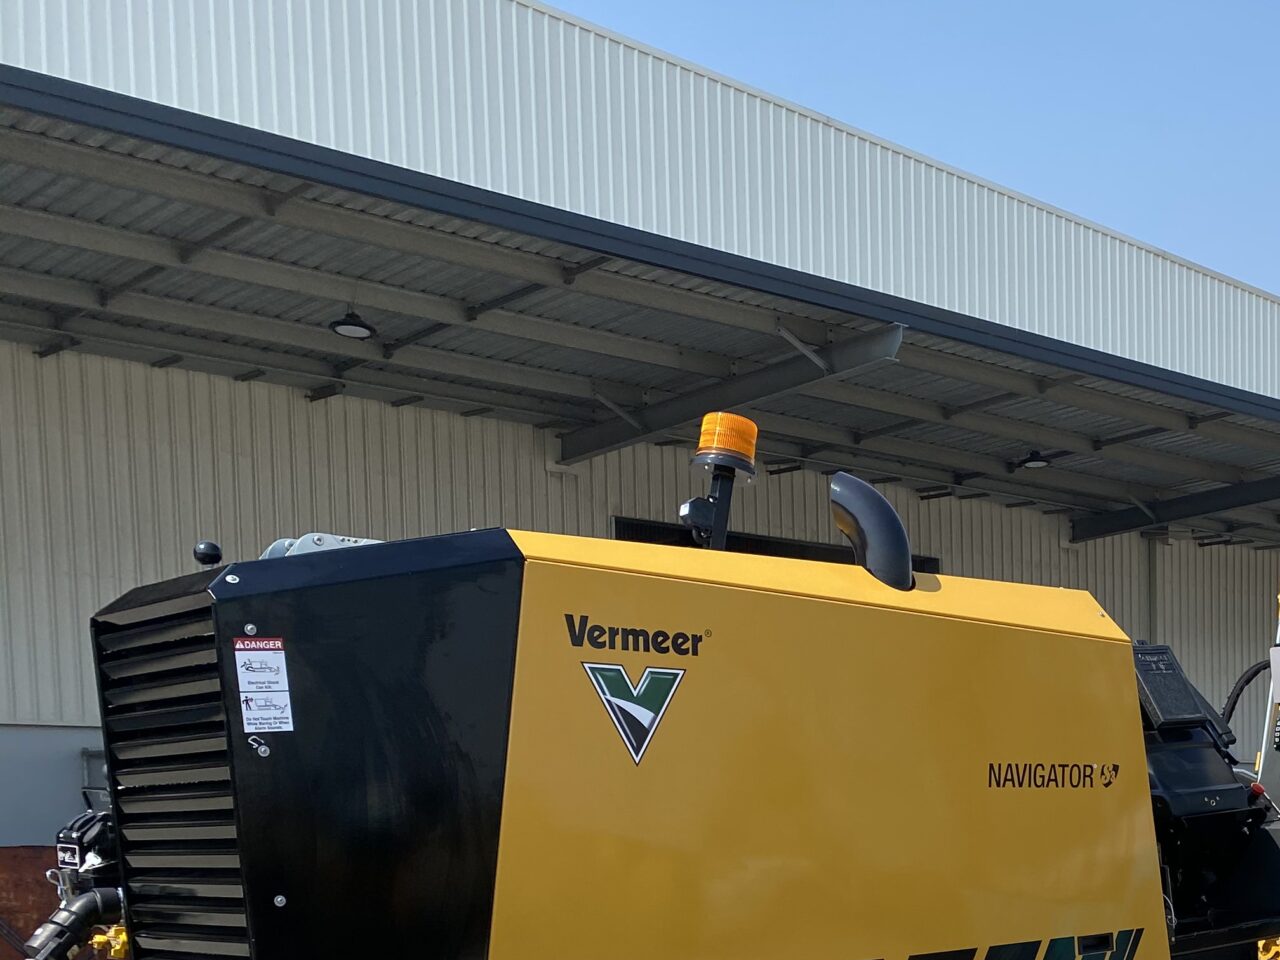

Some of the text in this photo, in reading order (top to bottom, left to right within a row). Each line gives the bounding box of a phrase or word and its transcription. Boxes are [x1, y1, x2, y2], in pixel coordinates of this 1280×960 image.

[244, 640, 282, 649] DANGER
[564, 613, 703, 656] Vermeer
[988, 763, 1094, 788] NAVIGATOR
